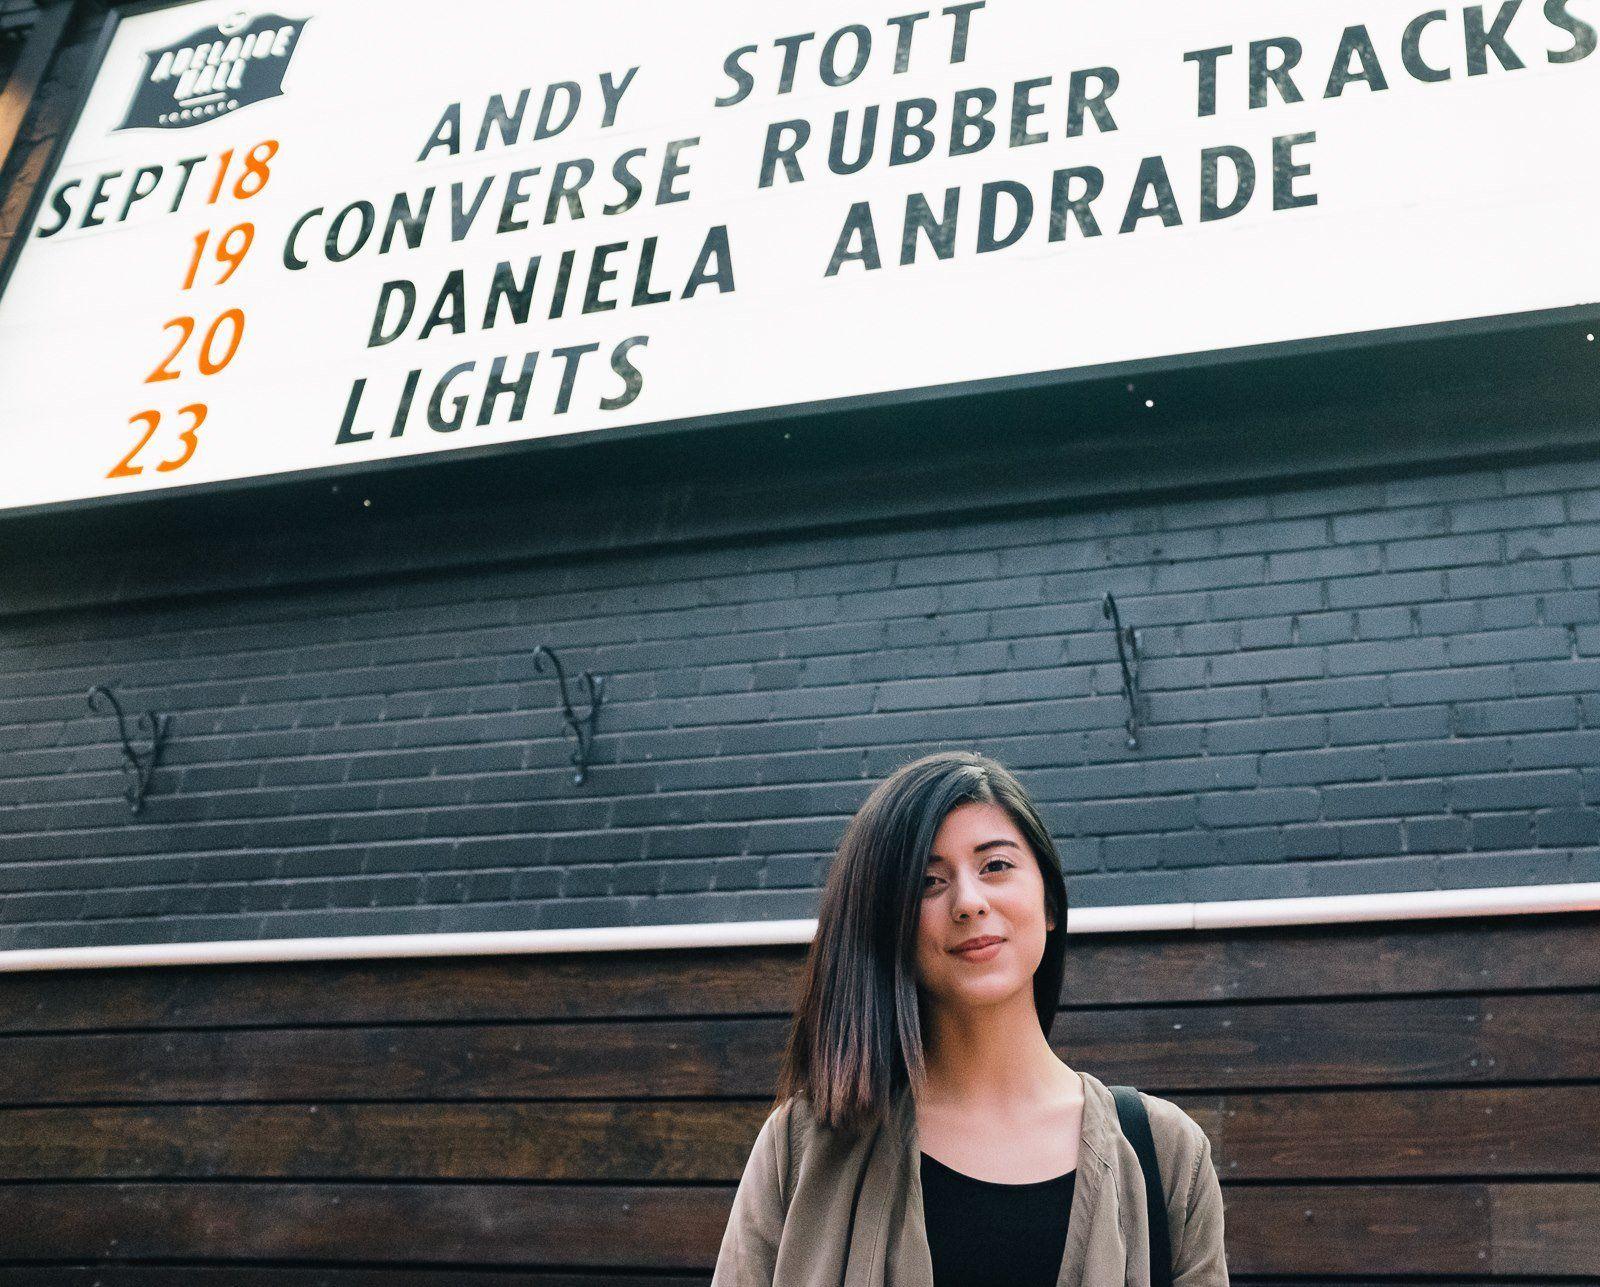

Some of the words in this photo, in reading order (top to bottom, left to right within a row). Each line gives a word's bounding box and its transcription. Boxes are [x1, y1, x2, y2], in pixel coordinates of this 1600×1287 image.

[36, 155, 208, 239] SEPT
[207, 139, 280, 205] 18
[416, 66, 640, 162] ANDY
[714, 0, 986, 108] STOTT
[182, 221, 255, 291] 19
[282, 136, 701, 271] CONVERSE
[758, 66, 1120, 189] RUBBER
[1183, 0, 1597, 118] TRACKS
[144, 308, 246, 384] 20
[367, 224, 736, 349] DANIELA
[824, 131, 1320, 278] ANDRADE
[105, 402, 208, 479] 23
[334, 335, 650, 446] LIGHTS
